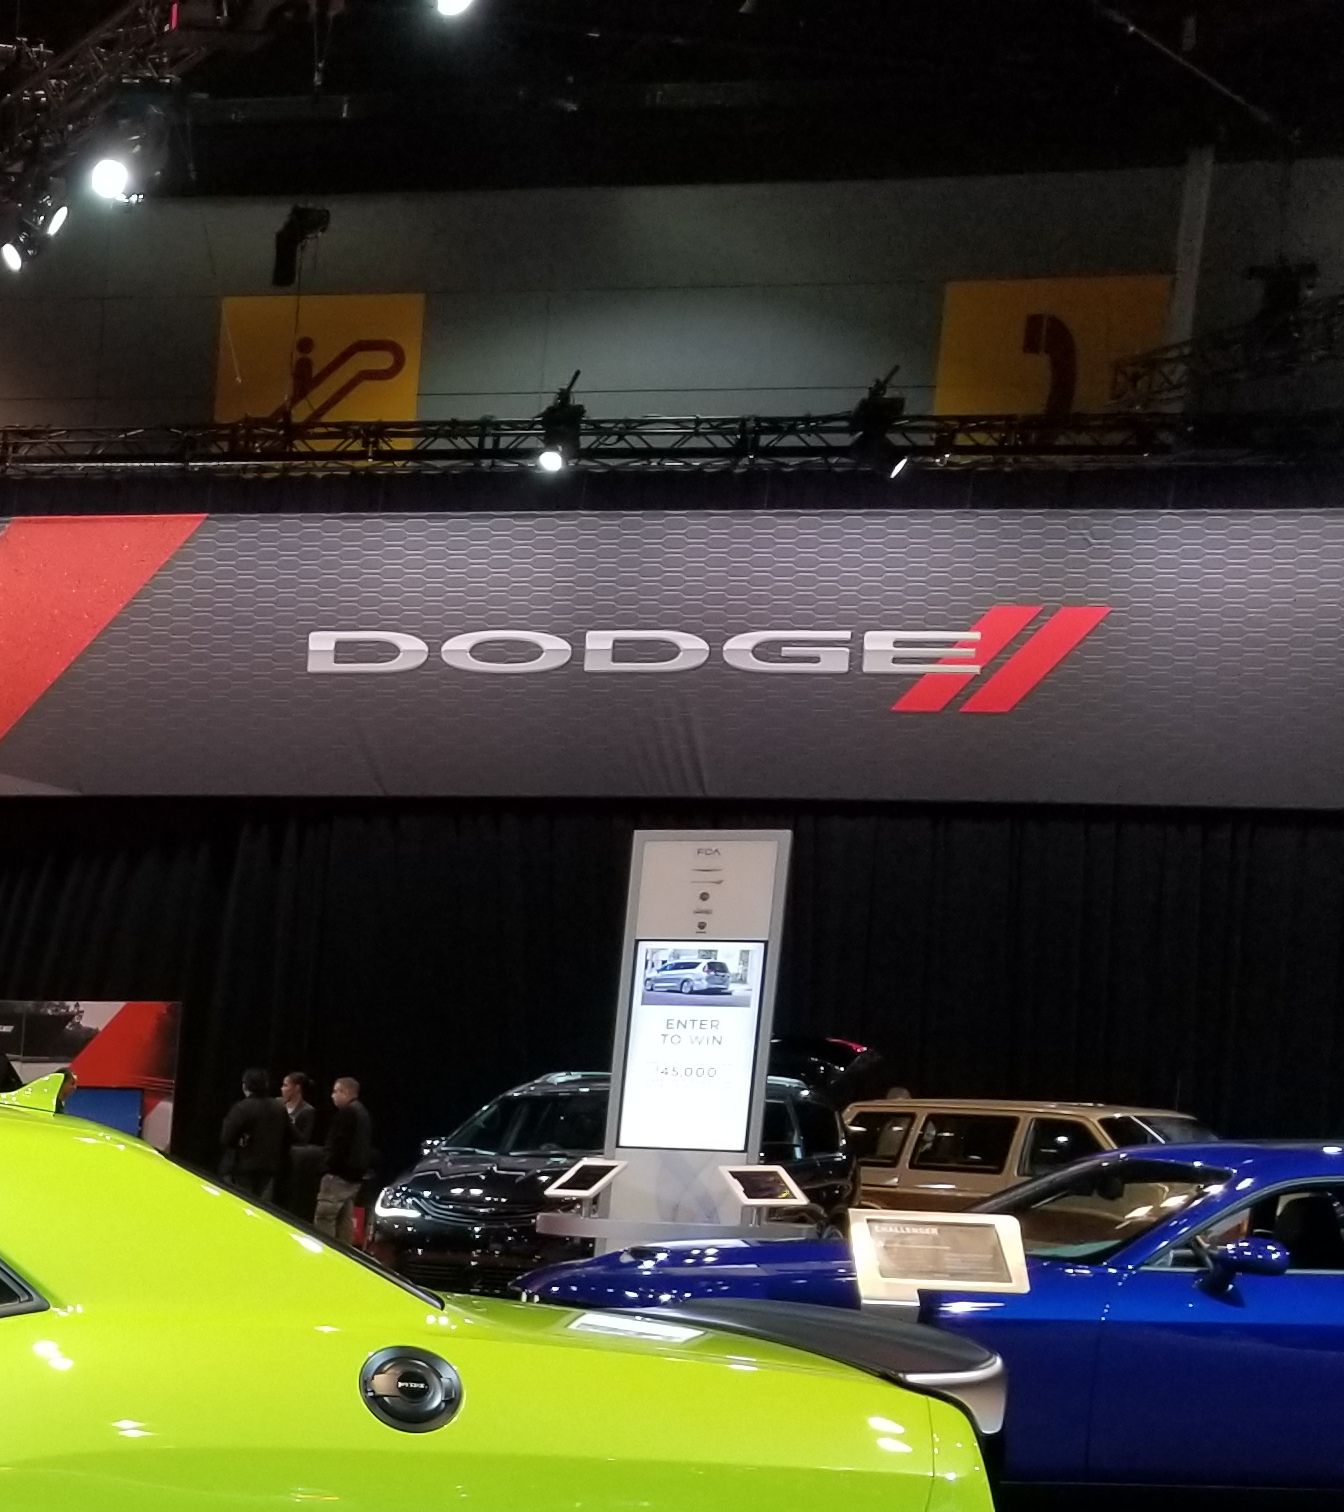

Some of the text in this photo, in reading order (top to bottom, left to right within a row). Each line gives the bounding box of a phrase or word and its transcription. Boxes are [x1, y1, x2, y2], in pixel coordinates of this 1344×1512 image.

[307, 630, 982, 674] DODGE
[665, 1018, 720, 1030] ENTER
[660, 1033, 723, 1046] TO WIN
